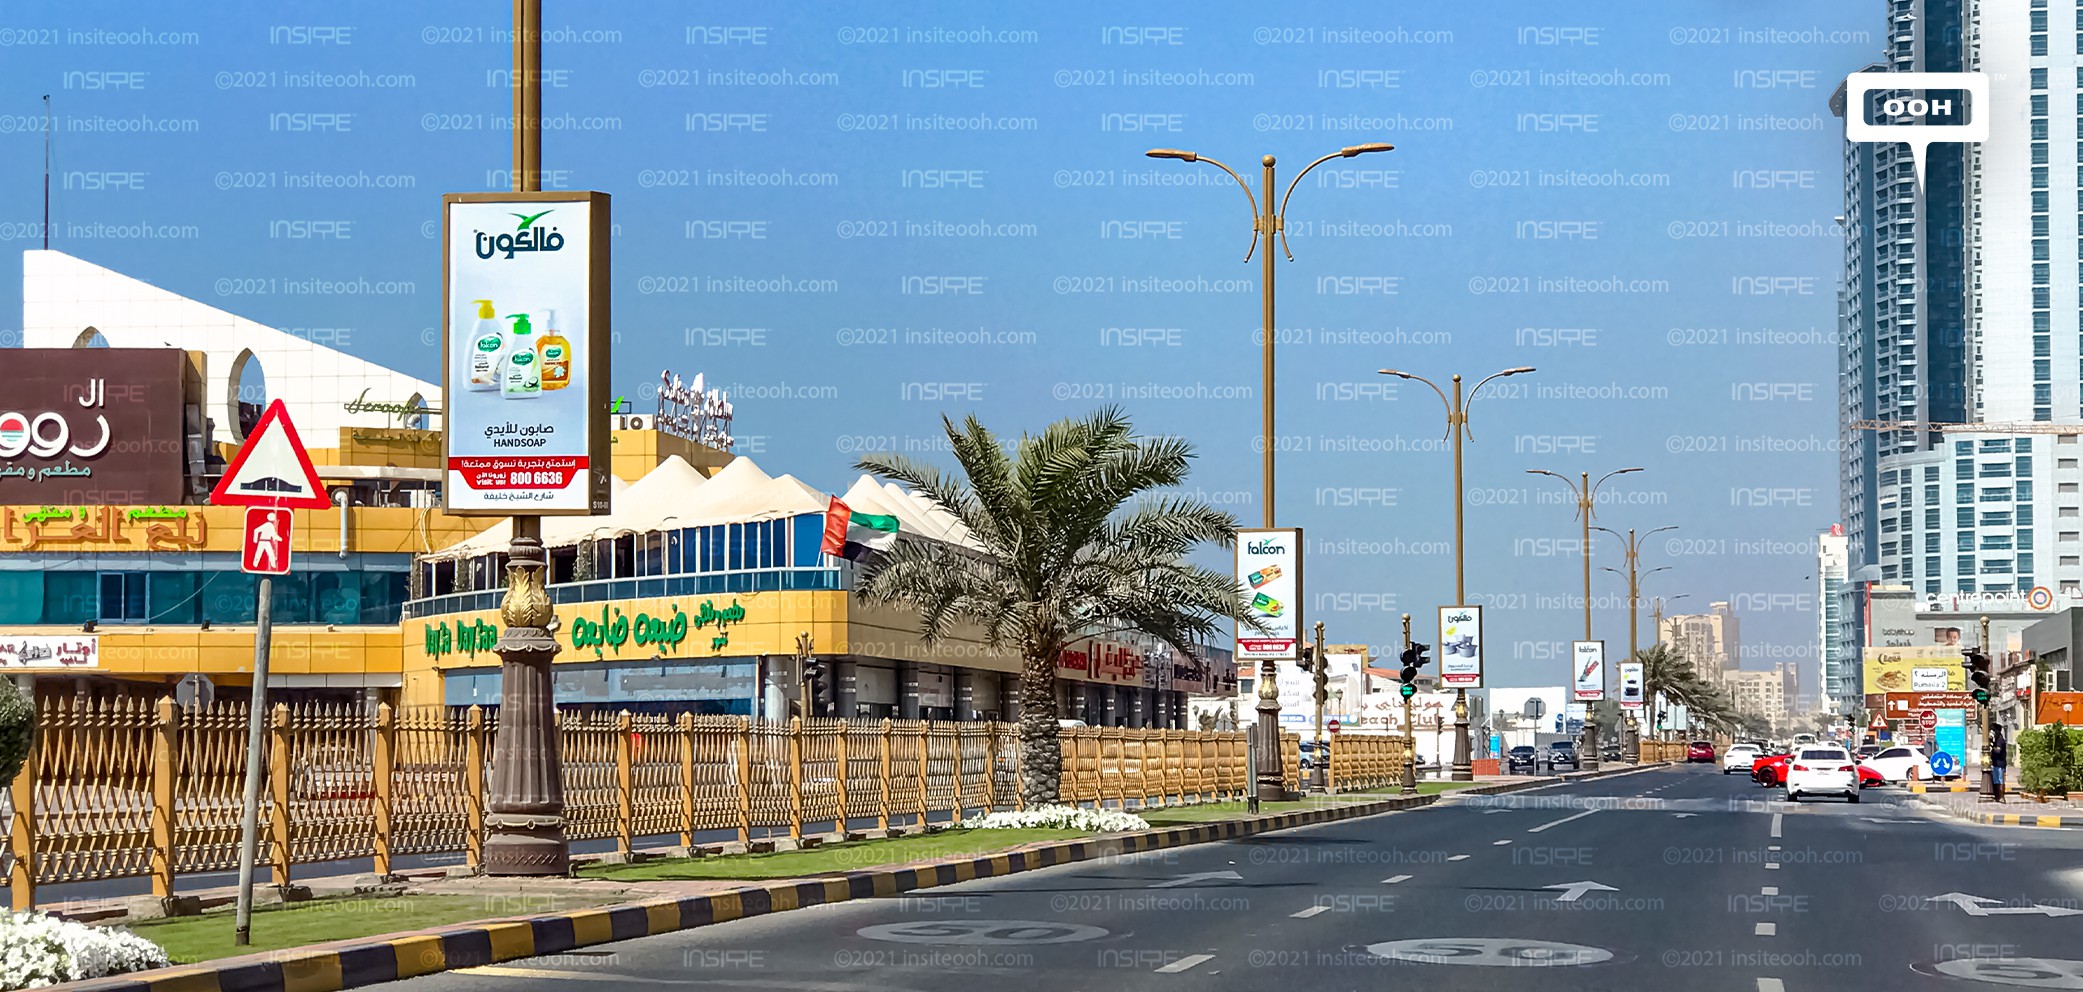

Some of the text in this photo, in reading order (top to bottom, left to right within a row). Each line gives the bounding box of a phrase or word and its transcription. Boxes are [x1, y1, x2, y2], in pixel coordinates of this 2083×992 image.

[475, 226, 565, 260] فالكون
[484, 421, 554, 439] صابون للأيدي
[493, 438, 547, 448] HANDSOAP
[38, 459, 92, 483] مطعم
[492, 459, 516, 470] تسوق
[517, 459, 545, 470] بتجربة
[510, 471, 563, 485] 800 6636
[483, 490, 554, 501] شارع الشيخ خليفة
[1247, 541, 1285, 555] falcon
[1925, 589, 2027, 606] centrepoint
